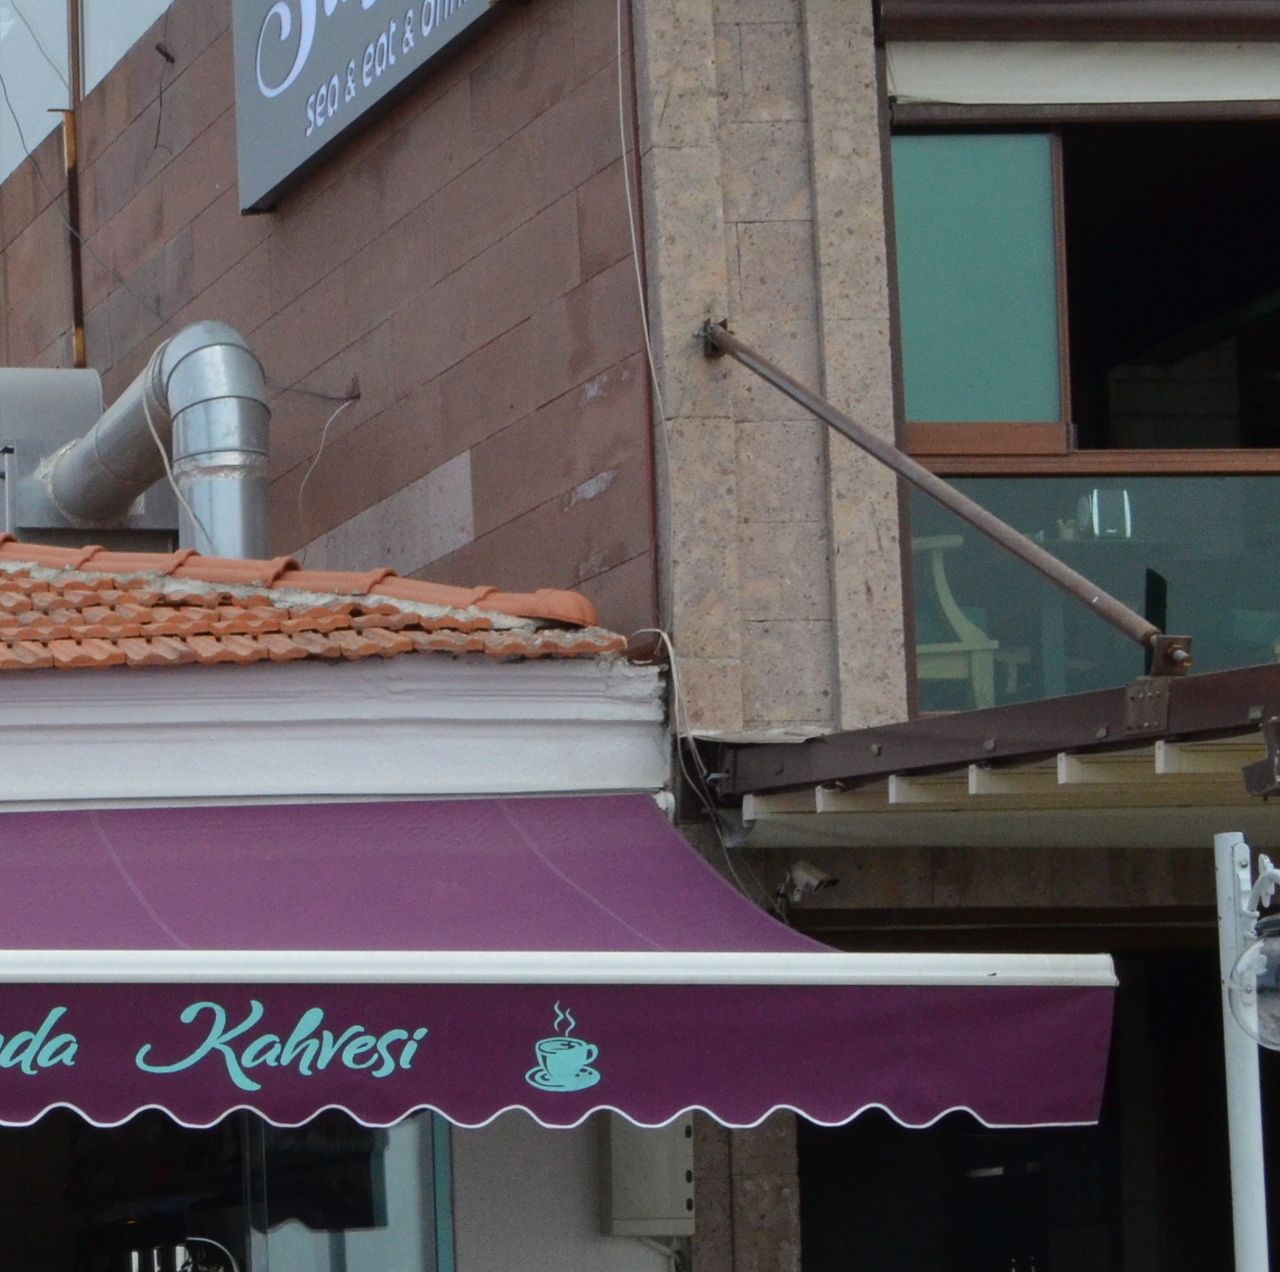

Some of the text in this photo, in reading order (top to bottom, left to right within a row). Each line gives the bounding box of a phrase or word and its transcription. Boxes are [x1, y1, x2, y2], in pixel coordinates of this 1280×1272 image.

[305, 74, 339, 138] sea
[344, 59, 356, 104] &
[361, 20, 397, 88] eat
[402, 9, 416, 54] &
[135, 1000, 429, 1092] Kahvesi
